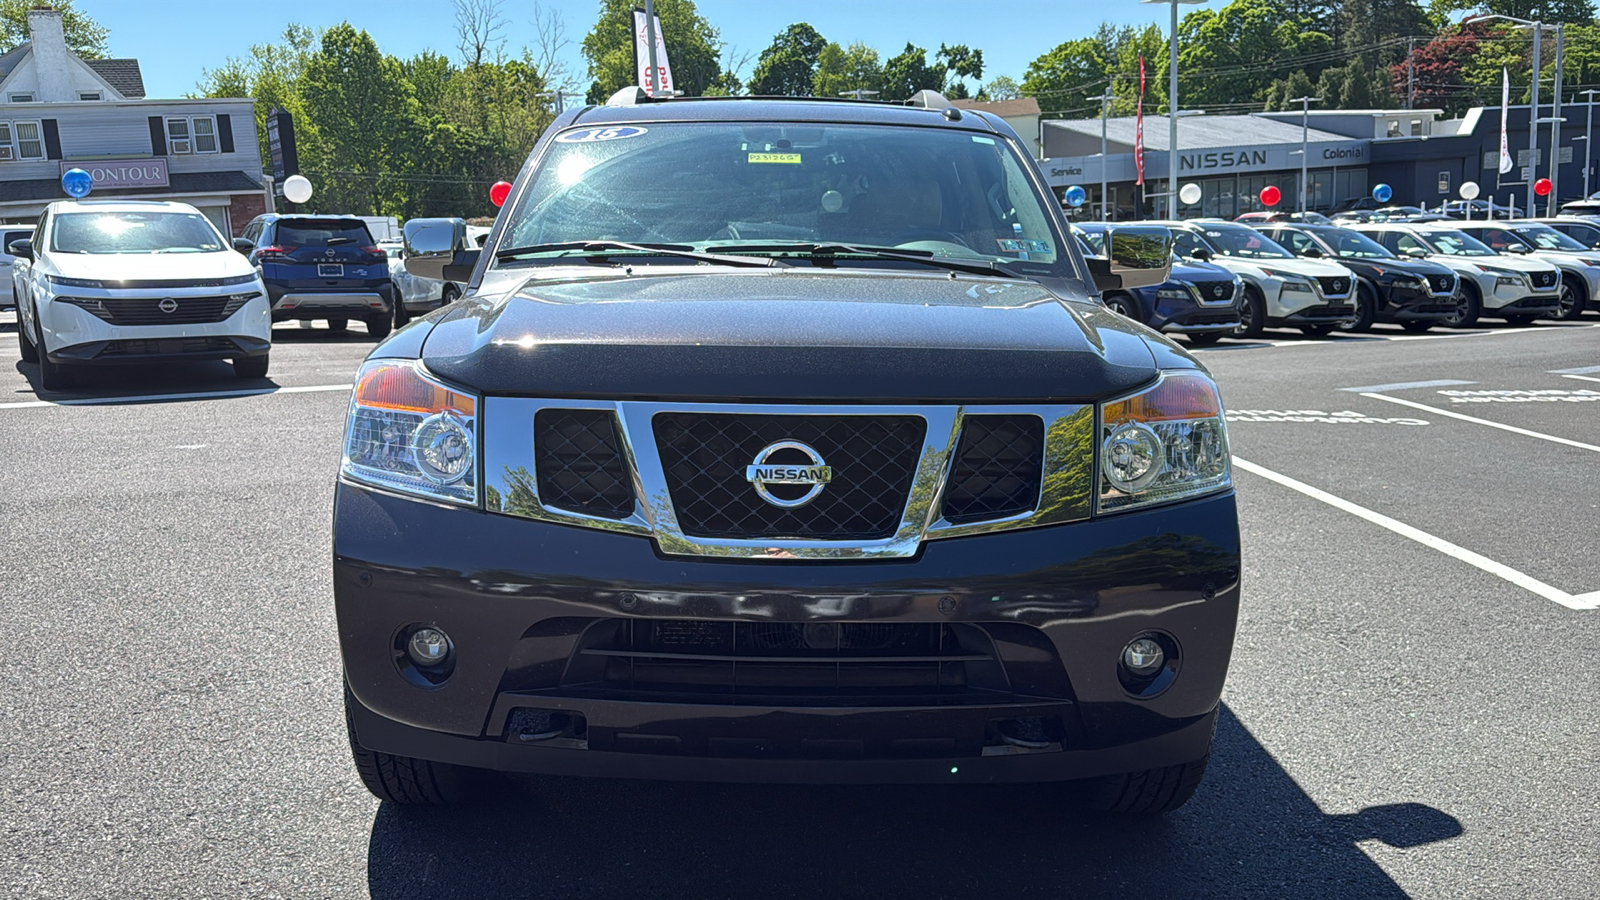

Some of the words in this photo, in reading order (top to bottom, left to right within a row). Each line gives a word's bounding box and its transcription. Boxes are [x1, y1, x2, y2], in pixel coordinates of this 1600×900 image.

[581, 128, 623, 140] 15
[1323, 146, 1364, 160] Colonial
[1180, 150, 1267, 171] NISSAN
[91, 166, 161, 182] ONTOUR
[1050, 166, 1083, 178] Service
[755, 468, 823, 480] NISSAN
